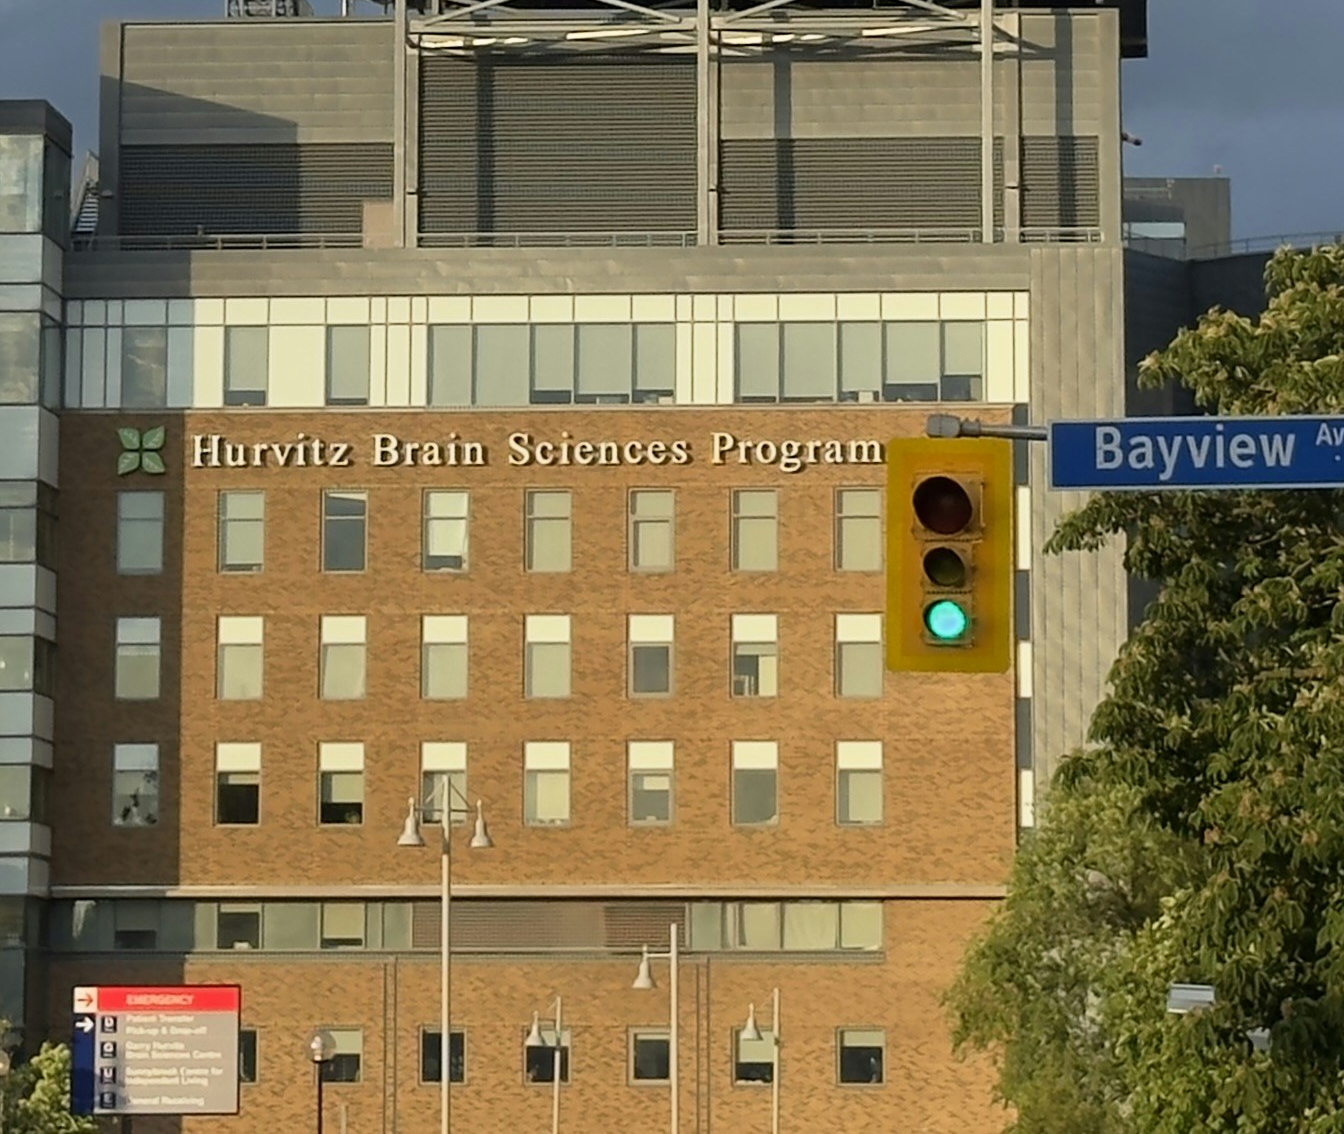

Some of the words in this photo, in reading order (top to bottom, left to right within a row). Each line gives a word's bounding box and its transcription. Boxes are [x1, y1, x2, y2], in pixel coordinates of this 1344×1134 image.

[192, 432, 350, 467] Hurvitz
[372, 432, 485, 467] Brain
[508, 431, 689, 466] Sciences
[710, 432, 884, 472] Program
[1095, 423, 1296, 481] Bayview
[126, 993, 195, 1005] EMERGENCY
[170, 1025, 207, 1036] Drop-off
